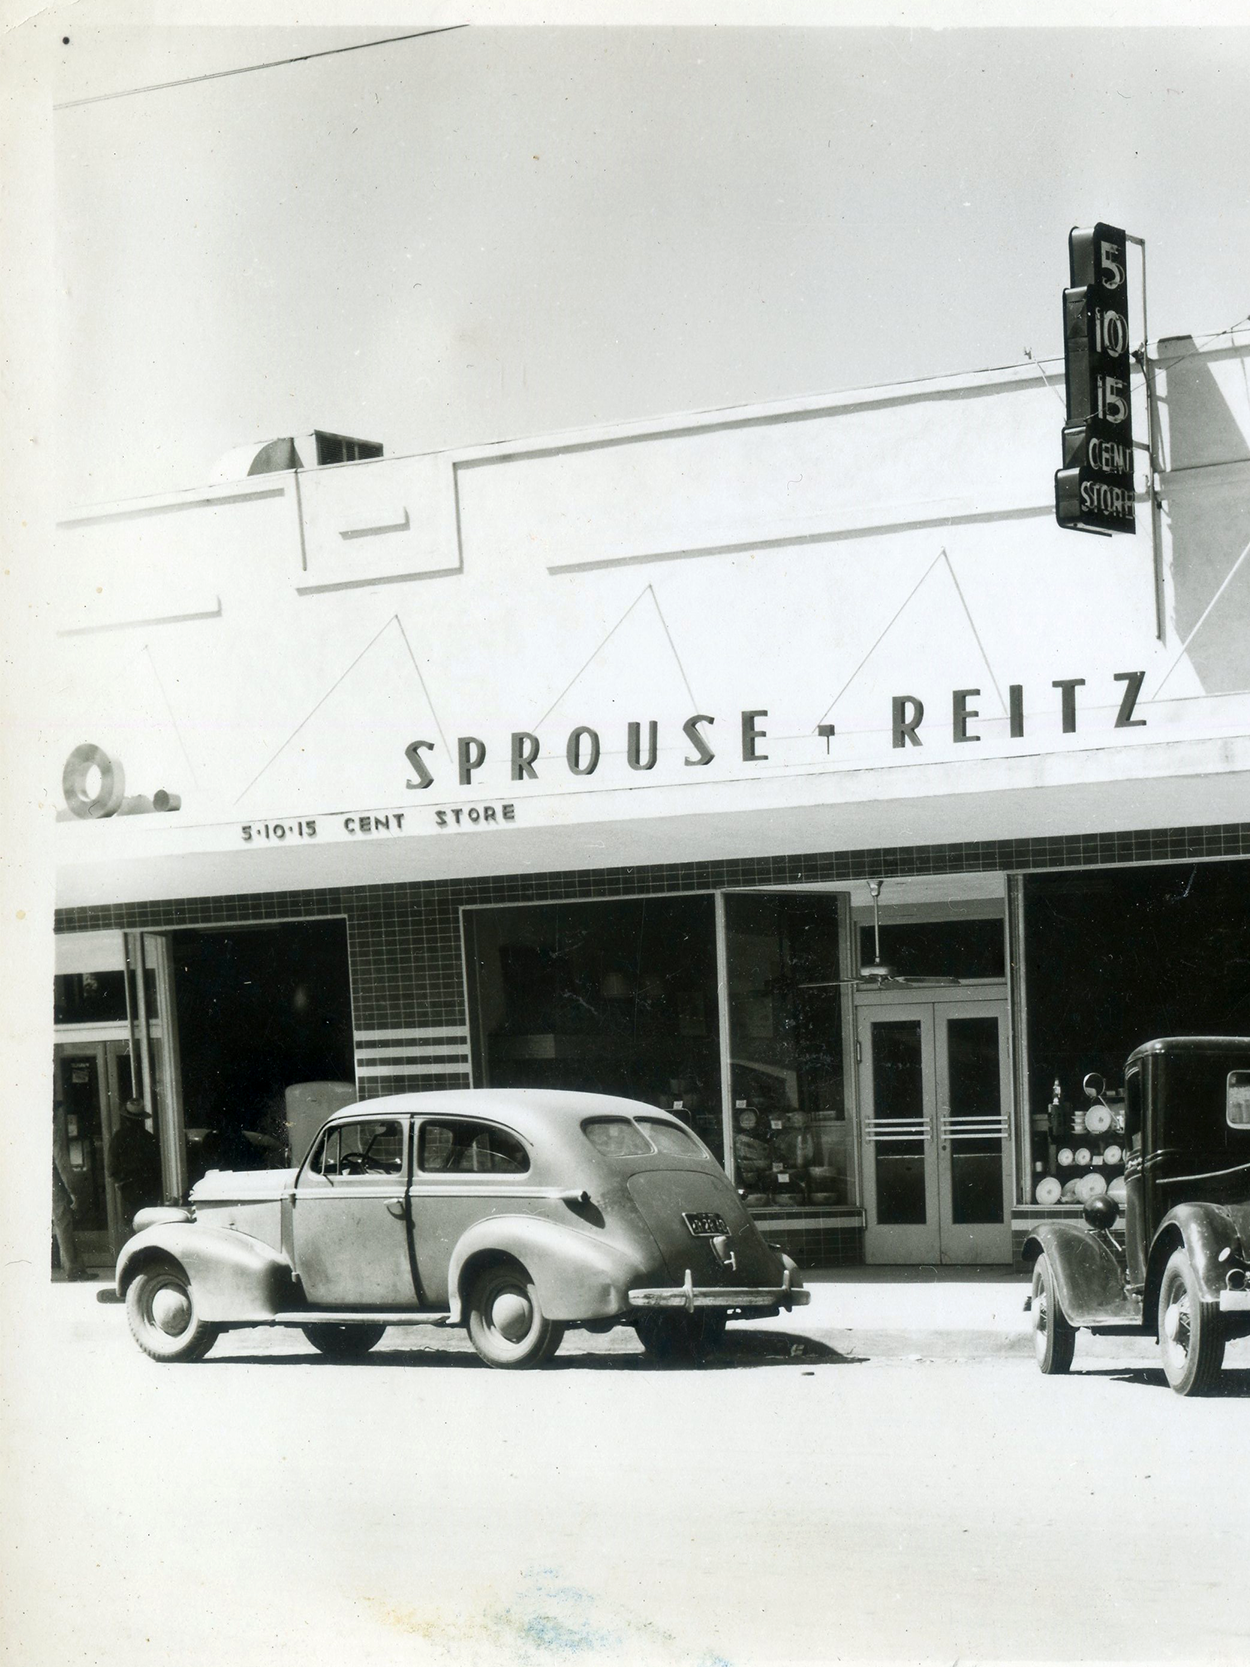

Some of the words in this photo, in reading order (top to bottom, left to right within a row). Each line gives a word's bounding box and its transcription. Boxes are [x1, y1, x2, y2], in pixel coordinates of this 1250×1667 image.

[1100, 240, 1125, 290] 5
[1095, 307, 1128, 358] 10
[1097, 374, 1128, 424] 15
[1080, 480, 1135, 520] STORE
[405, 709, 769, 790] SPROUSE
[892, 670, 1147, 749] REITZ
[344, 813, 405, 834] CENT
[435, 803, 516, 827] STORE
